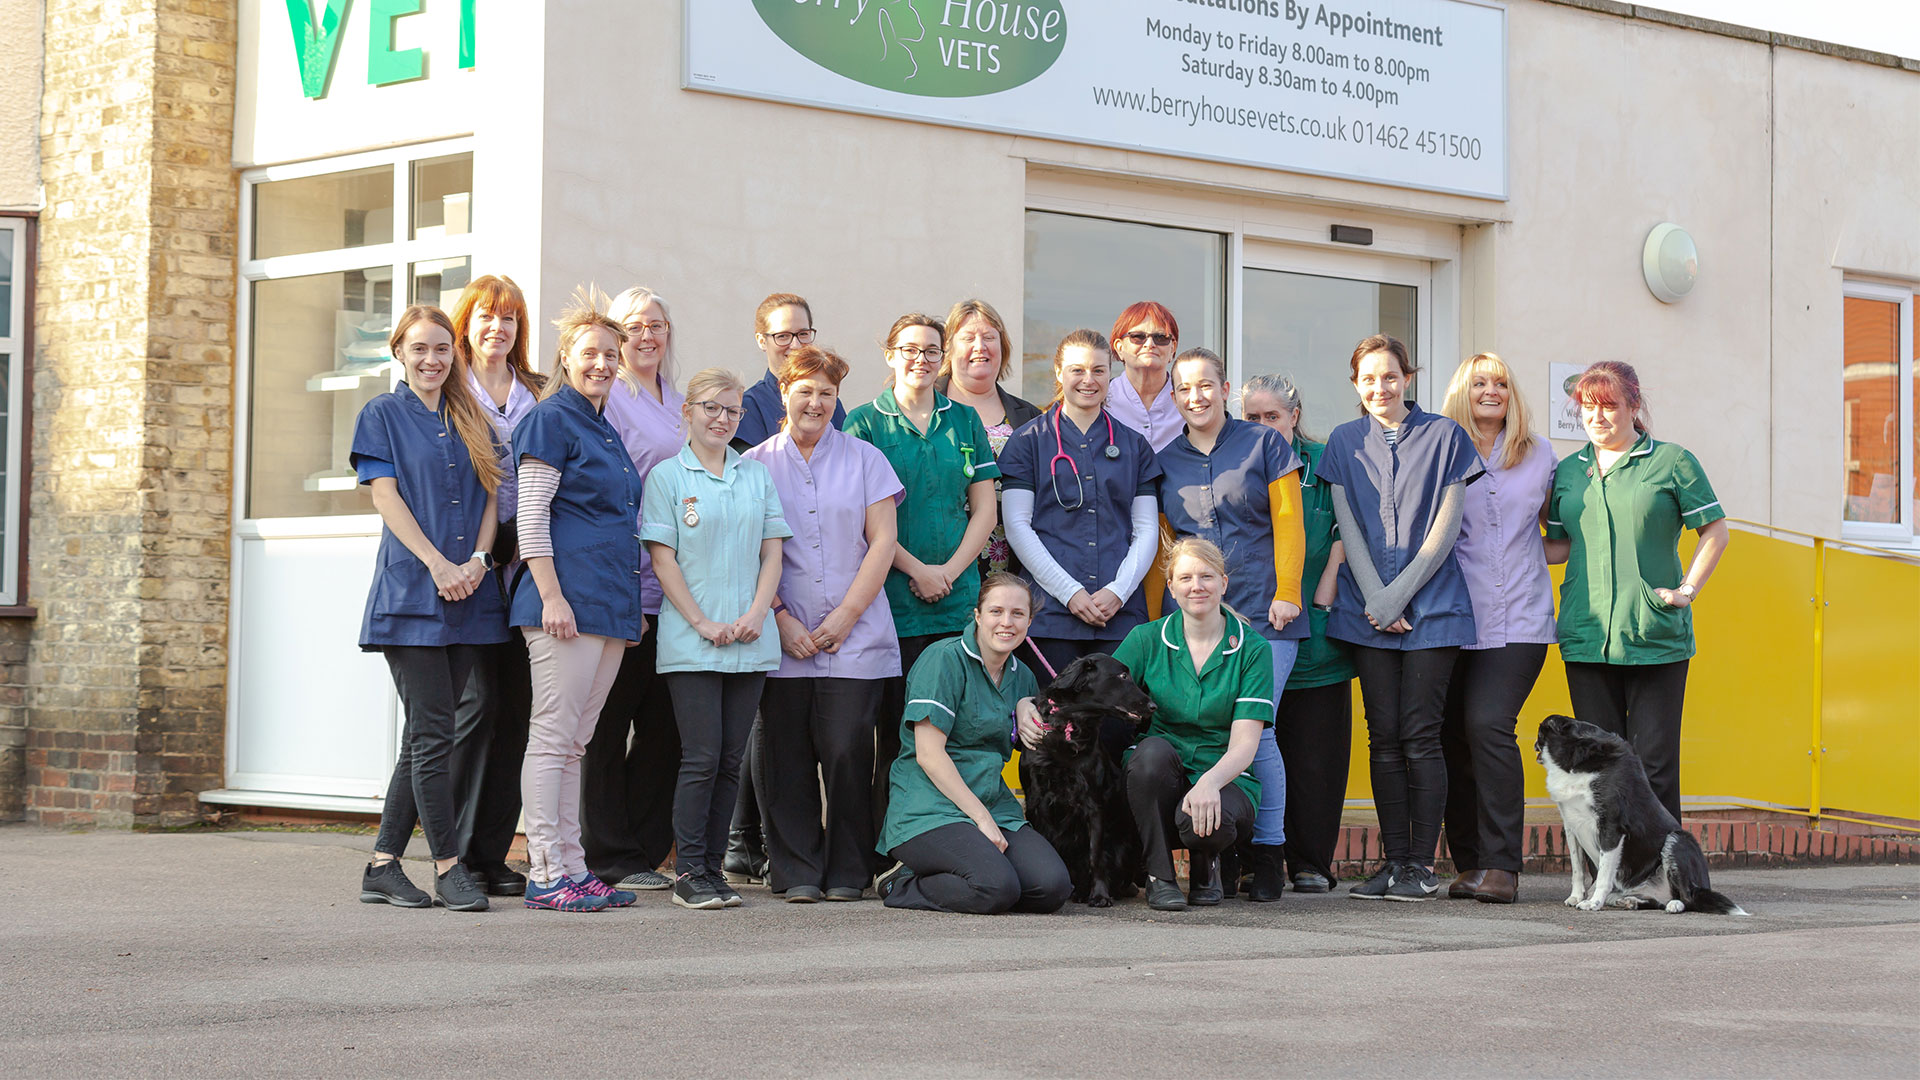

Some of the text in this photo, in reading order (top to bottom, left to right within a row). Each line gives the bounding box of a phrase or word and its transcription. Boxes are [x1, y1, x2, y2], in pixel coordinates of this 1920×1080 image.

[939, 0, 1061, 43] House
[1285, 0, 1310, 31] By
[1314, 3, 1443, 47] Appointment
[938, 36, 1001, 74] VETS
[1146, 17, 1430, 86] Monday to Friday 8.00am to 8.00pm
[1181, 53, 1399, 109] Saturday 8.30am to 4.00pm
[1092, 86, 1481, 161] www.berryhousevets.co.uk 01462 451500
[1558, 419, 1575, 432] Berry
